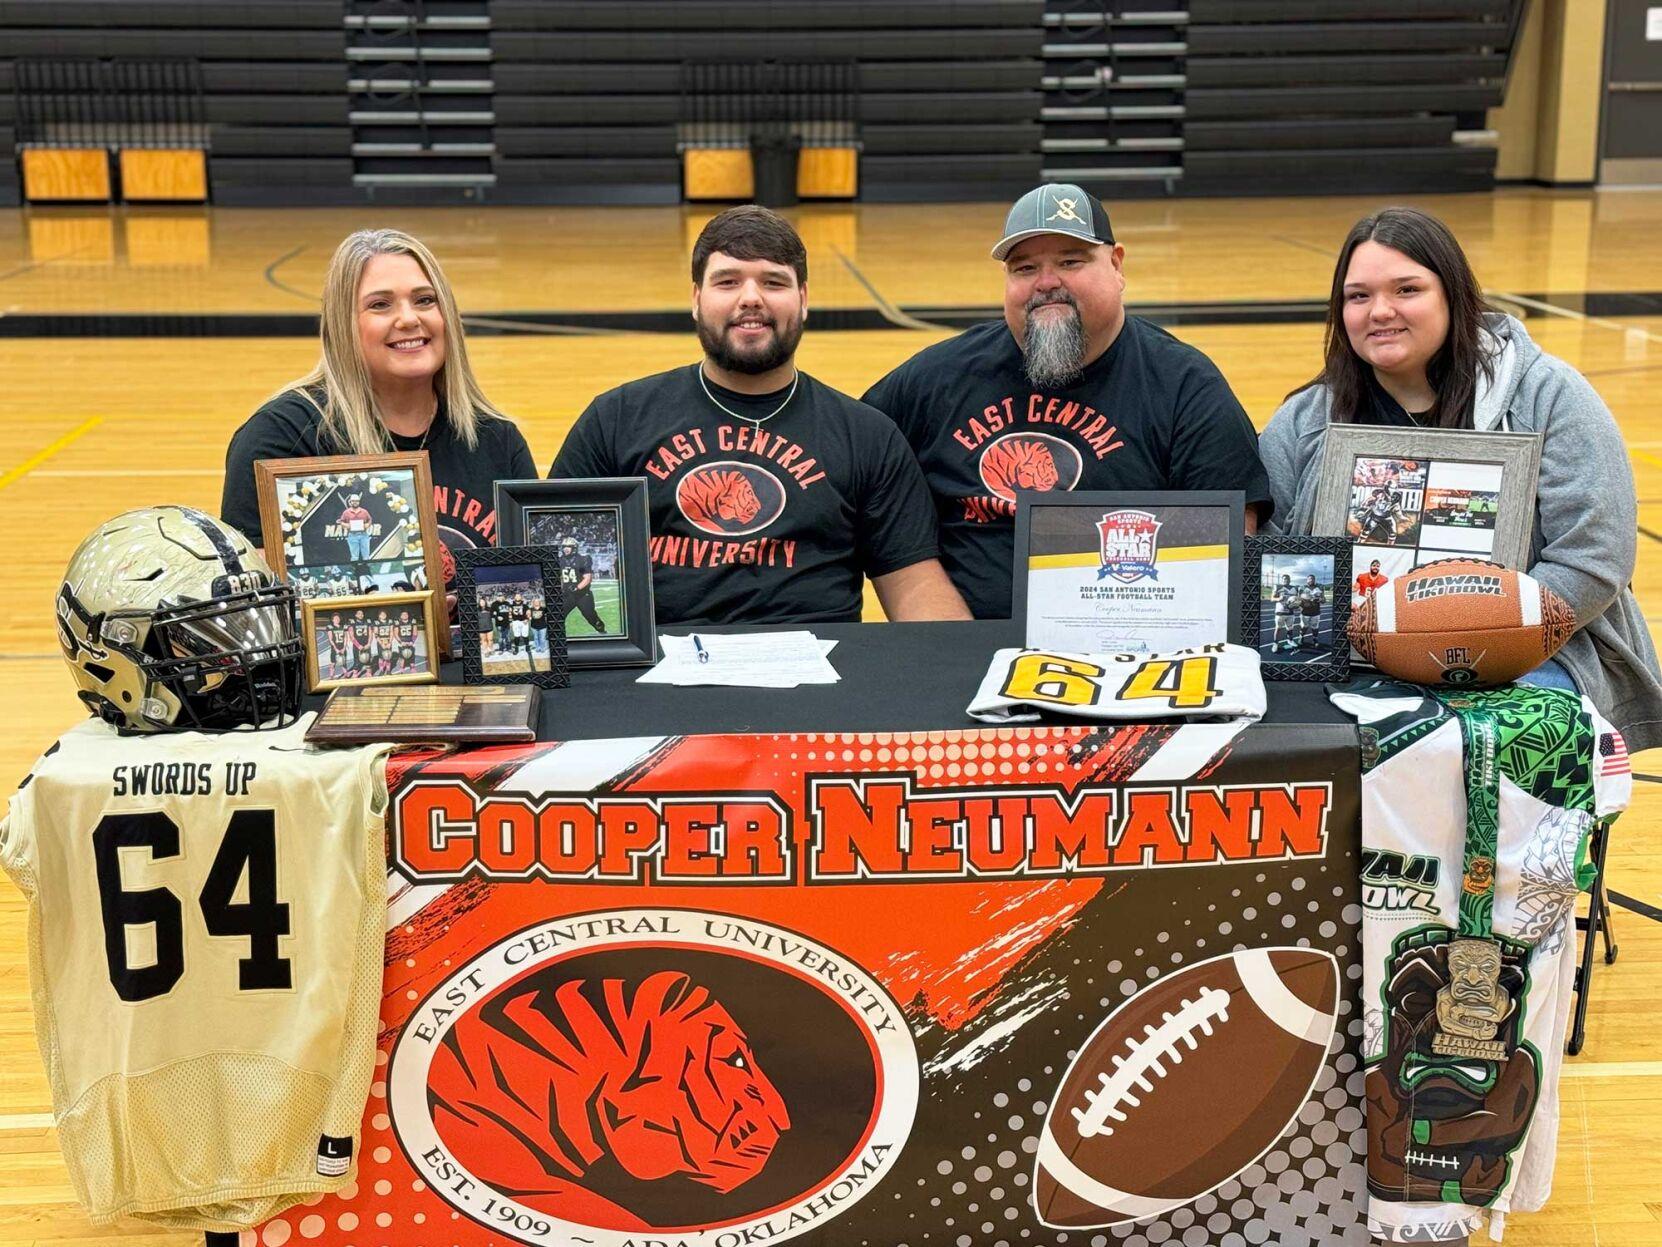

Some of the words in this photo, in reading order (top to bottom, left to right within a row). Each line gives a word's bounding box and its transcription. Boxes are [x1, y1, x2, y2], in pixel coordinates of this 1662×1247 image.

[952, 397, 1015, 452] EAST
[1027, 394, 1127, 461] CENTRAL
[645, 428, 707, 482] EAST
[718, 425, 827, 490] CENTRAL
[433, 485, 497, 546] NTRA
[650, 534, 797, 568] UNIVERSITY
[1106, 542, 1151, 557] STAR
[1107, 528, 1140, 543] ALL
[561, 569, 578, 583] 64
[1406, 574, 1502, 595] HAWAII
[1405, 586, 1446, 604] TIKI
[1445, 646, 1471, 666] BFL
[997, 653, 1224, 709] 64
[112, 762, 212, 797] SWORDS
[225, 762, 257, 796] UP
[394, 777, 793, 882] COOPER
[808, 777, 1333, 880] NEUMANN
[92, 808, 293, 1003] 64
[1362, 882, 1441, 916] OWL
[411, 968, 488, 1044] EAST
[502, 915, 680, 967] CENTRAL
[703, 919, 897, 1037] UNIVERSITY
[1432, 1033, 1507, 1052] HAWAII
[327, 1141, 338, 1154] L
[421, 1144, 476, 1200] EST.
[481, 1198, 552, 1236] 1909
[714, 1143, 894, 1247] OKLAHOMA
